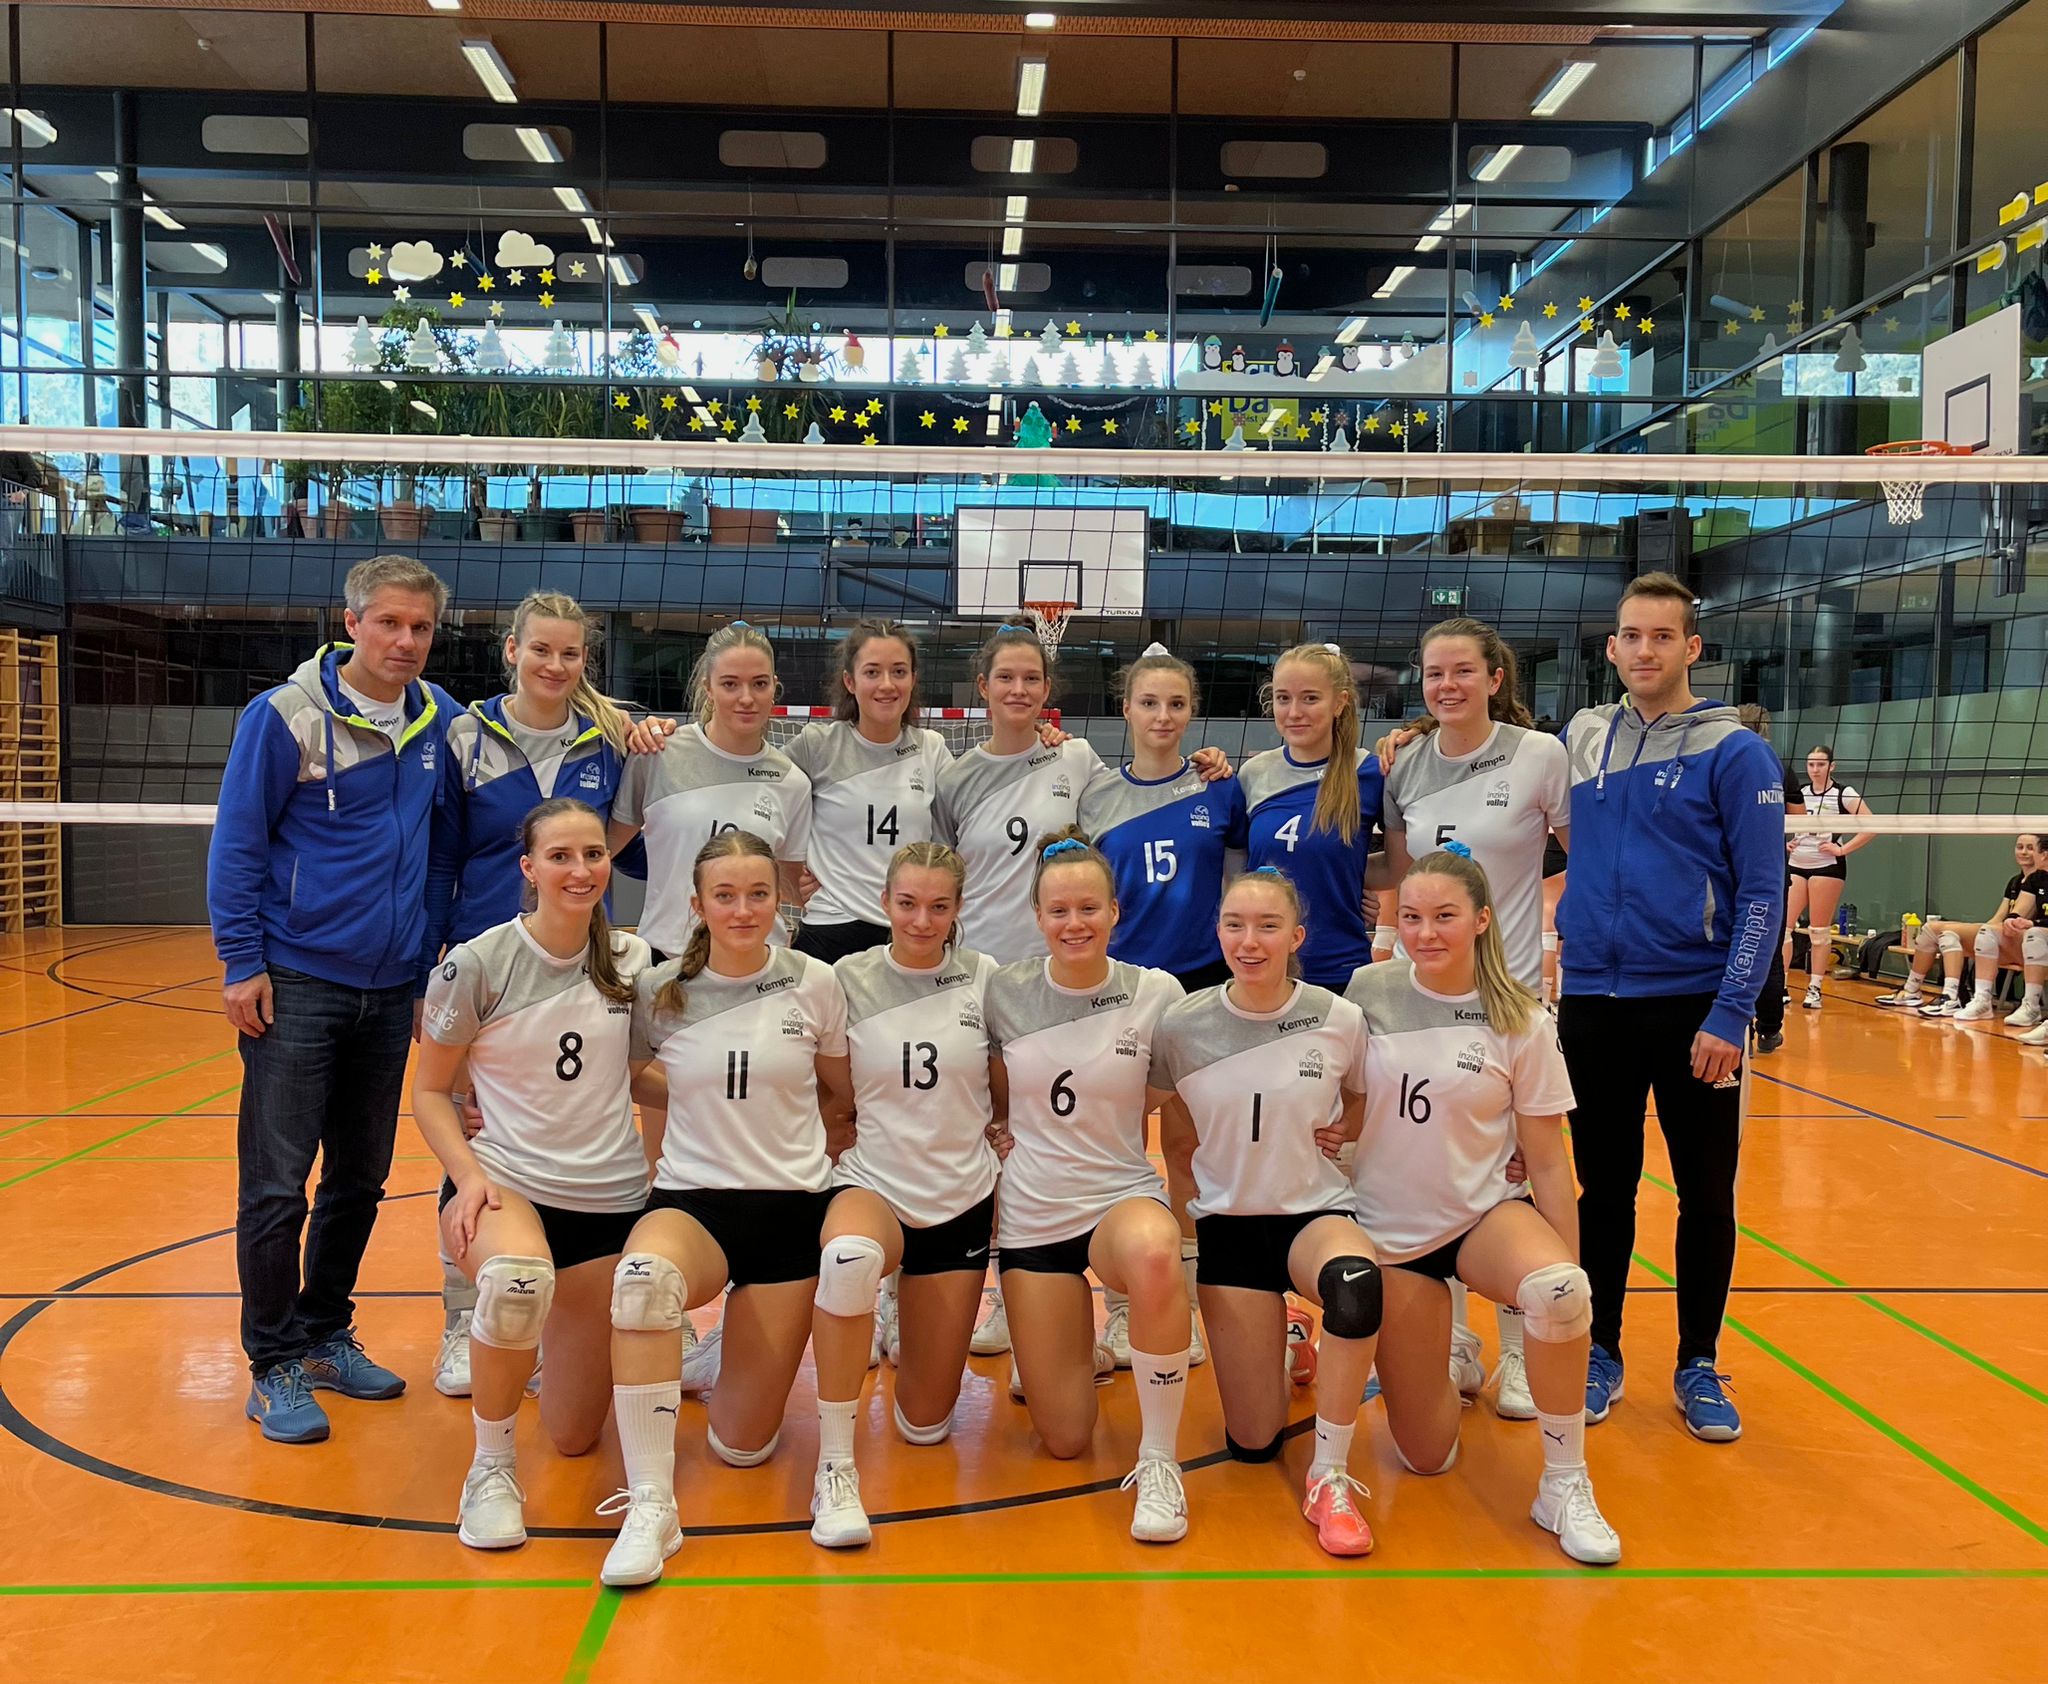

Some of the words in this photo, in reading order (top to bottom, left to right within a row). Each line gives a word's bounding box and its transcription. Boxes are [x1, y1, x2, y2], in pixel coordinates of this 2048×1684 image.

[1470, 754, 1505, 772] Kempa
[748, 768, 780, 778] Kempa
[1486, 799, 1508, 807] volley
[1487, 791, 1509, 800] inzing
[867, 804, 899, 845] 14
[1006, 816, 1028, 856] 9
[1274, 815, 1302, 852] 4
[1144, 840, 1177, 883] 15
[1722, 900, 1769, 989] Kempa
[756, 976, 794, 994] Kempa
[1091, 992, 1129, 1009] Kempa
[607, 1007, 630, 1015] volley
[1455, 1009, 1488, 1022] Kemp
[782, 1018, 804, 1030] inzing
[782, 1027, 803, 1036] volley
[1278, 1016, 1319, 1033] Kempa
[1115, 1047, 1137, 1057] volley
[1116, 1039, 1138, 1049] inzing
[556, 1032, 583, 1081] 8
[1458, 1051, 1484, 1066] inzing
[903, 1042, 938, 1090] 13
[1299, 1060, 1323, 1071] inzing
[1456, 1060, 1482, 1074] volley
[727, 1051, 748, 1099] 11
[1299, 1069, 1322, 1080] volley
[1051, 1069, 1076, 1117] 6
[1400, 1073, 1431, 1124] 16
[1252, 1093, 1261, 1142] 1
[1150, 1376, 1183, 1386] erima
